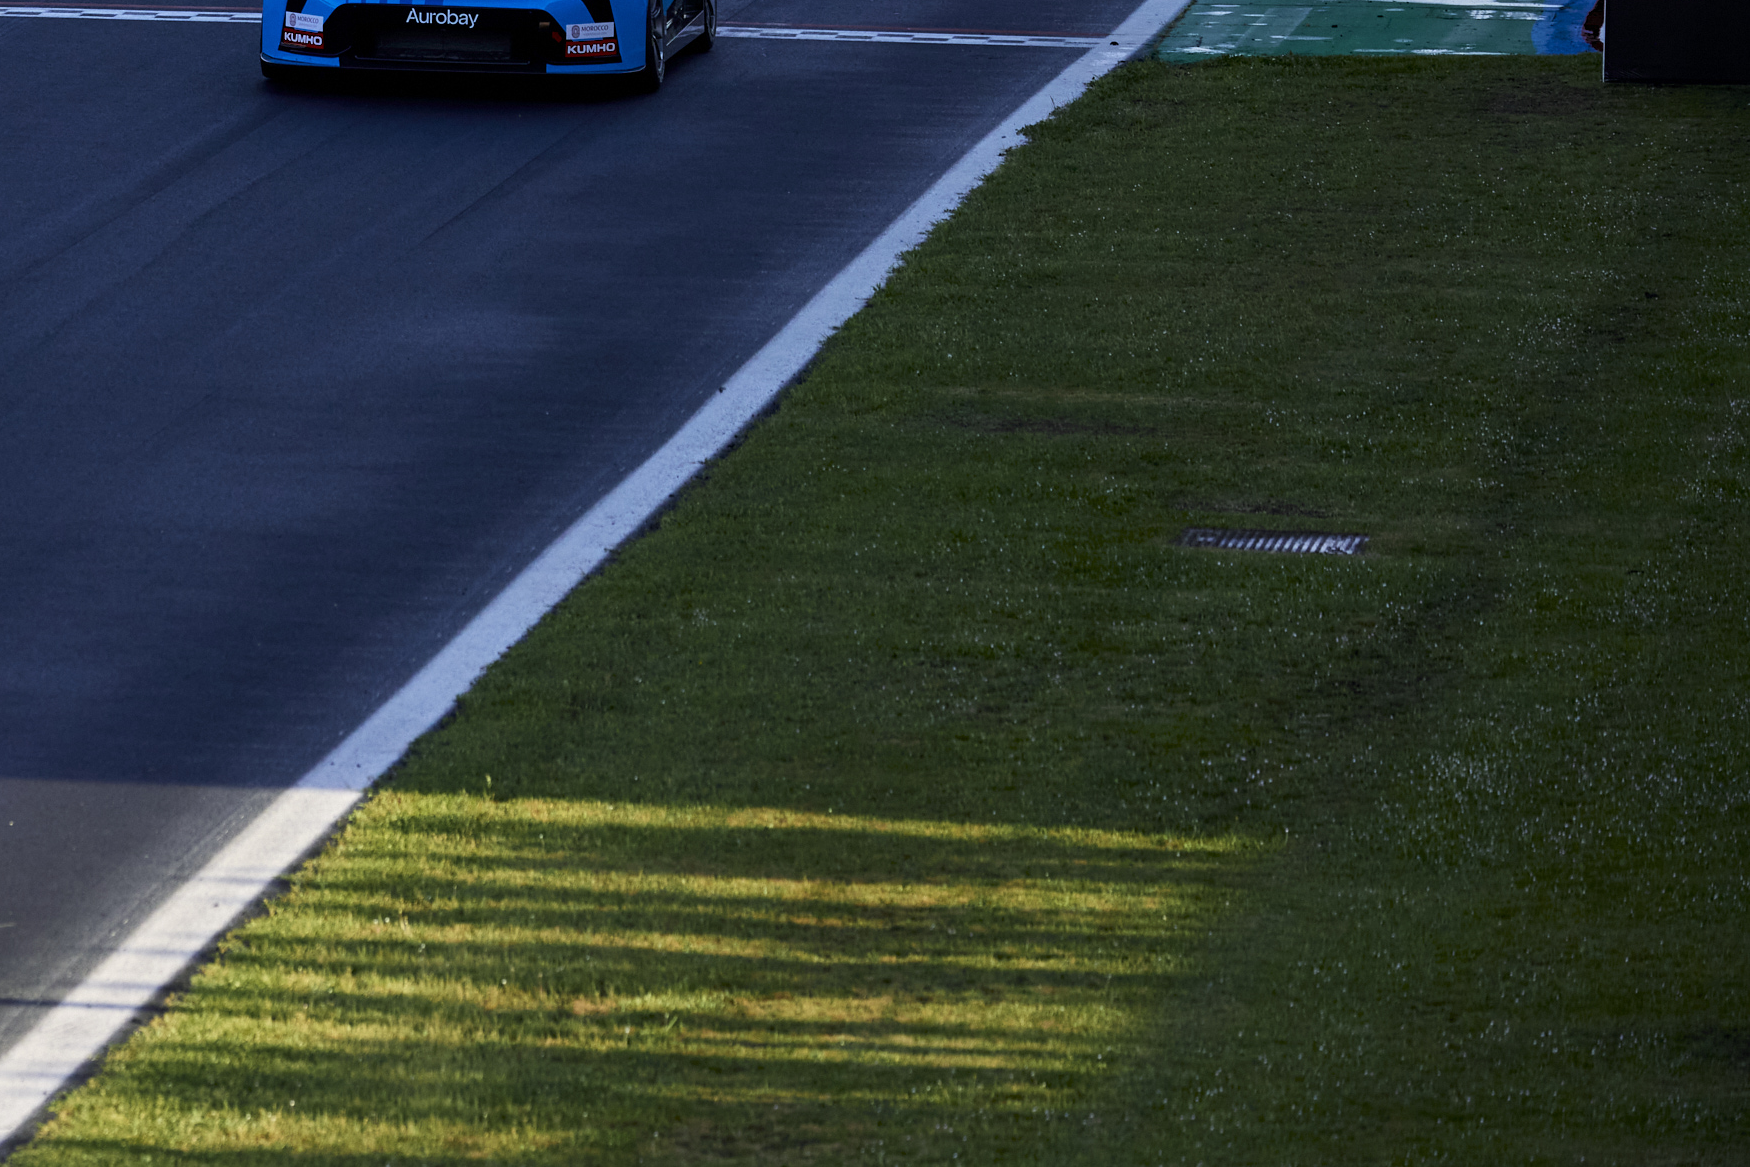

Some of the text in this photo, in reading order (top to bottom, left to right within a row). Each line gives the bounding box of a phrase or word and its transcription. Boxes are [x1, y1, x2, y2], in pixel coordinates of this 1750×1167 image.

[406, 8, 479, 28] Aurobay
[581, 25, 610, 34] MOROCCO
[283, 31, 324, 47] KUMHO
[566, 39, 617, 55] KUMHO
